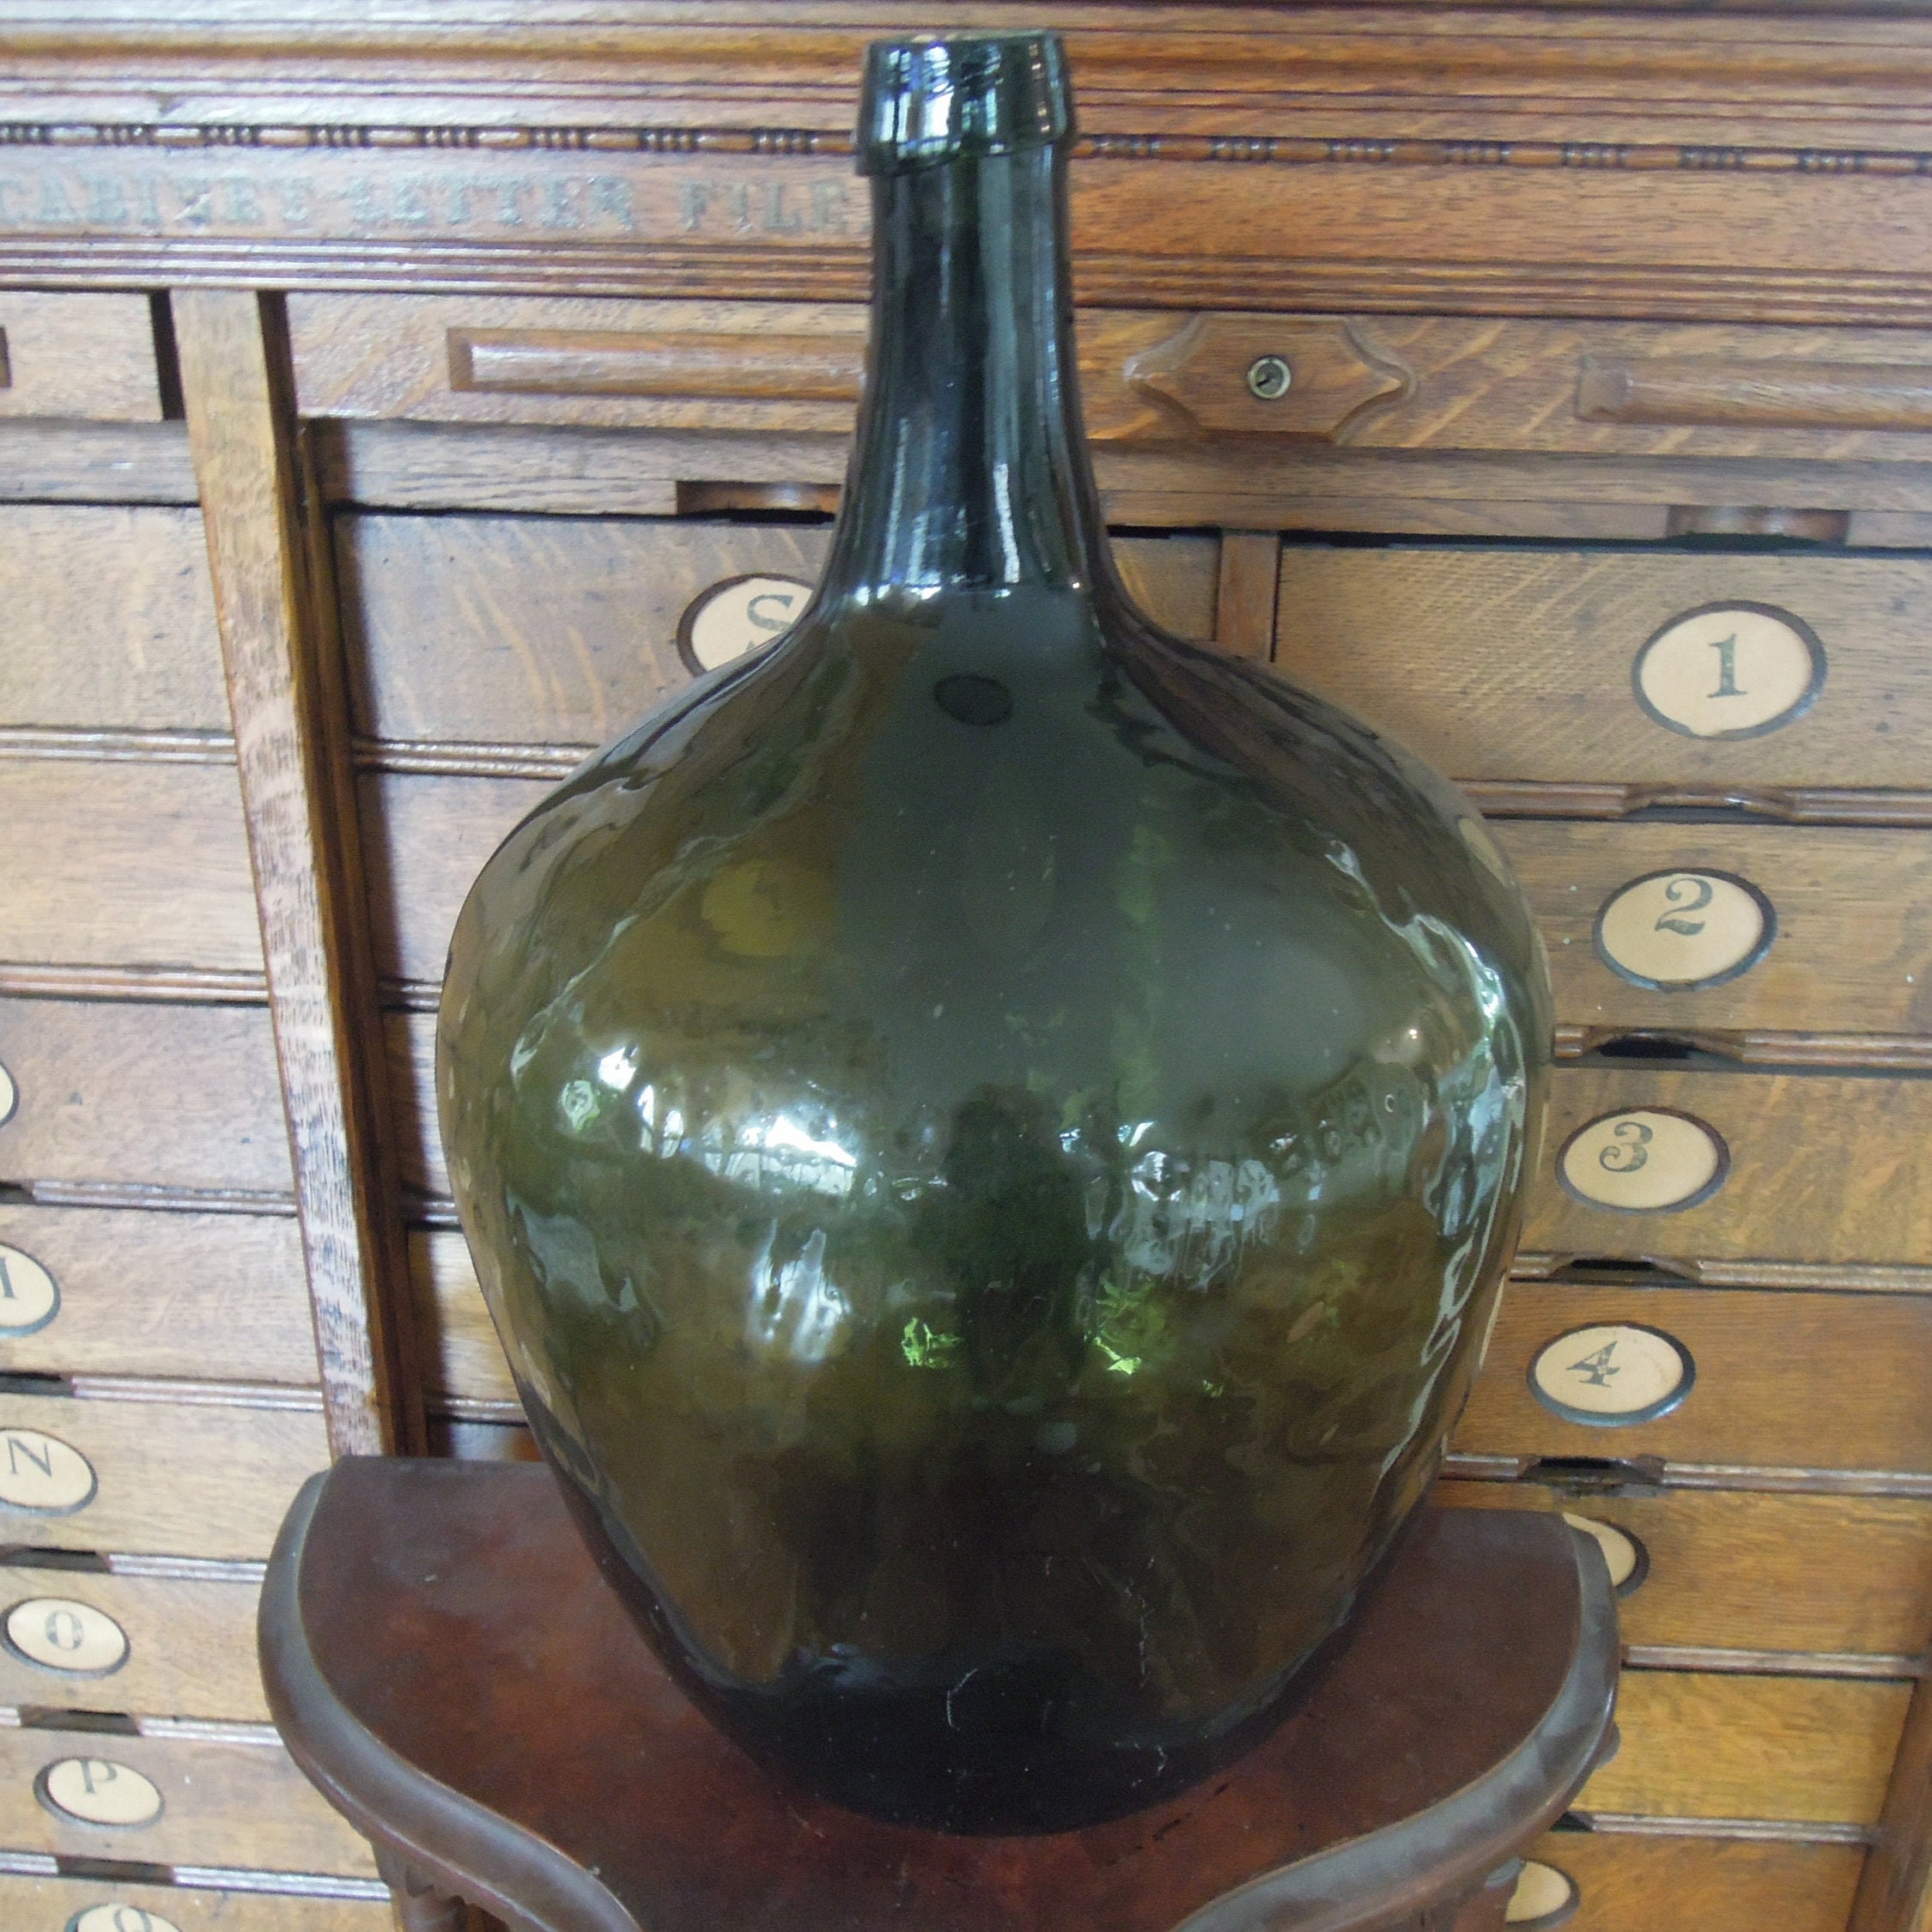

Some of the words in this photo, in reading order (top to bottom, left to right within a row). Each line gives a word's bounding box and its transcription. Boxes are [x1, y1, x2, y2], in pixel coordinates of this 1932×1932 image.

[1707, 633, 1747, 699] 1
[1654, 878, 1714, 936] 2
[1599, 1121, 1653, 1173] 3
[1566, 1340, 1620, 1388] 4
[7, 1437, 52, 1478] N
[79, 1757, 117, 1795] P
